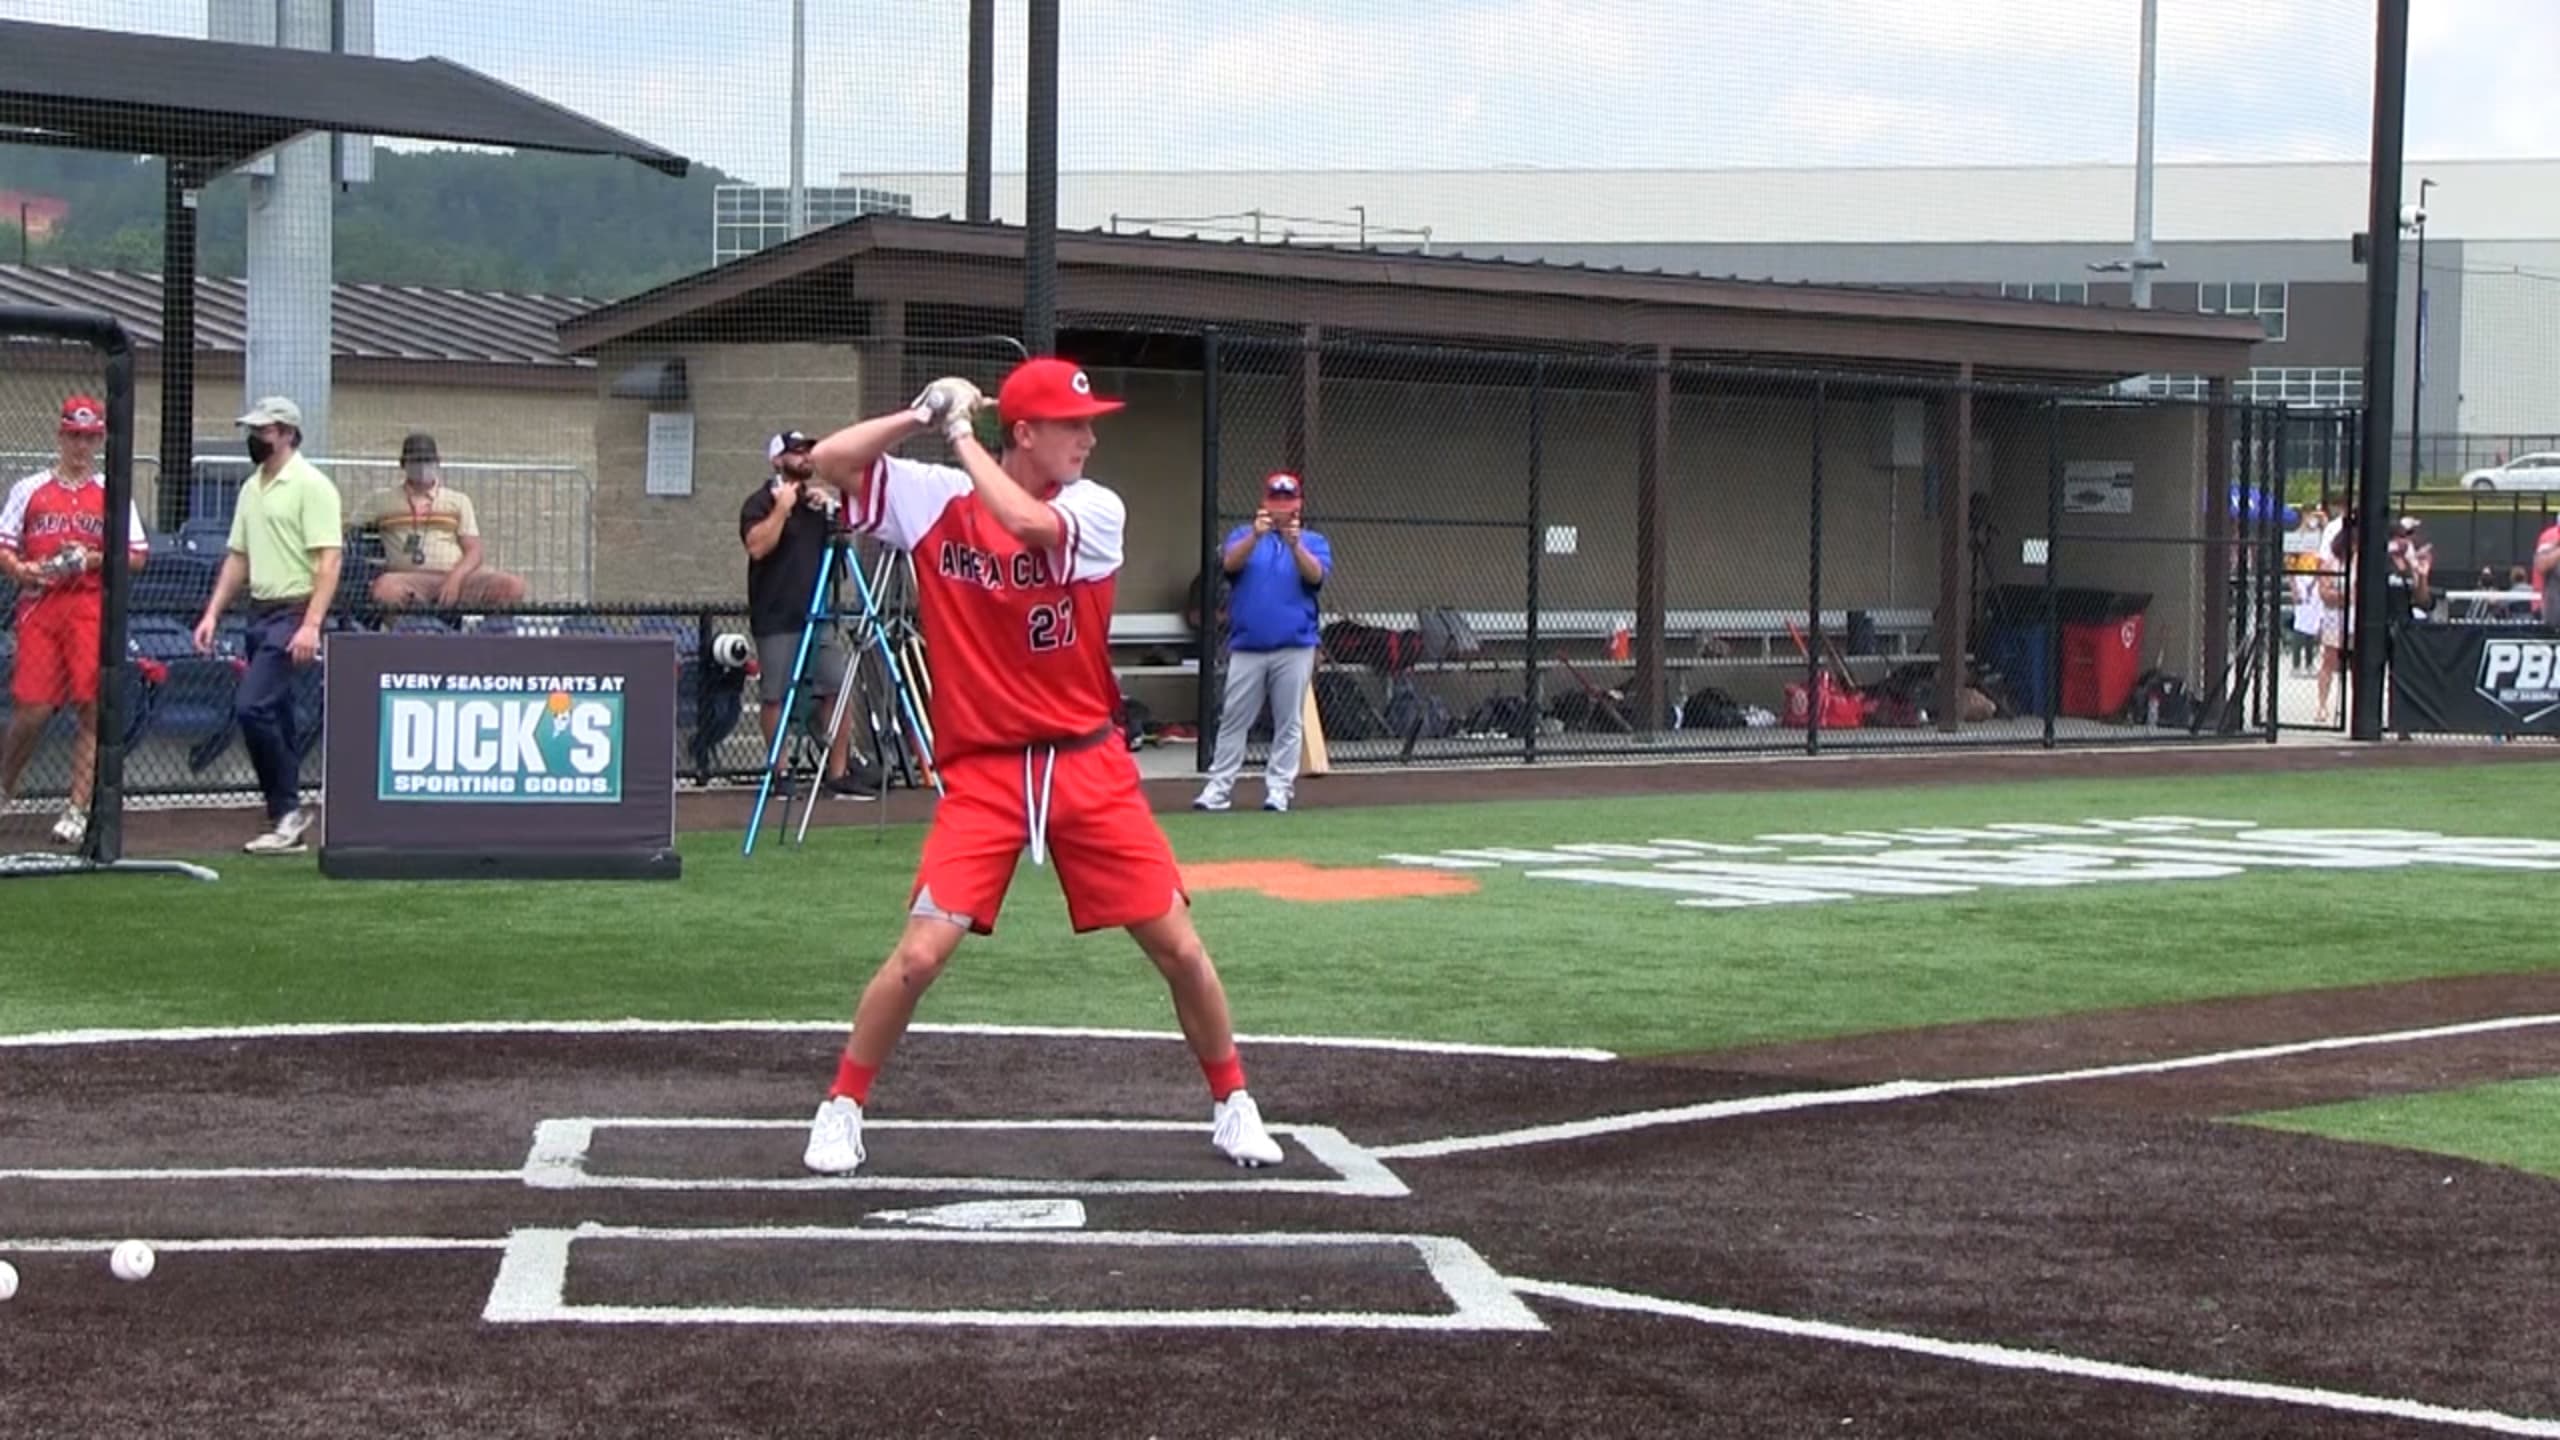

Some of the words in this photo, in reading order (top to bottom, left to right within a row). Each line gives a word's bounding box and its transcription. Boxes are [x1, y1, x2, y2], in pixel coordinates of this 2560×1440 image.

[1071, 370, 1090, 395] C
[1027, 597, 1076, 651] 27
[380, 673, 442, 689] EVERY
[446, 675, 523, 691] SEASON
[527, 676, 597, 692] STARTS
[600, 676, 625, 692] AT
[394, 775, 515, 793] SPORTING
[525, 777, 608, 794] GOODS
